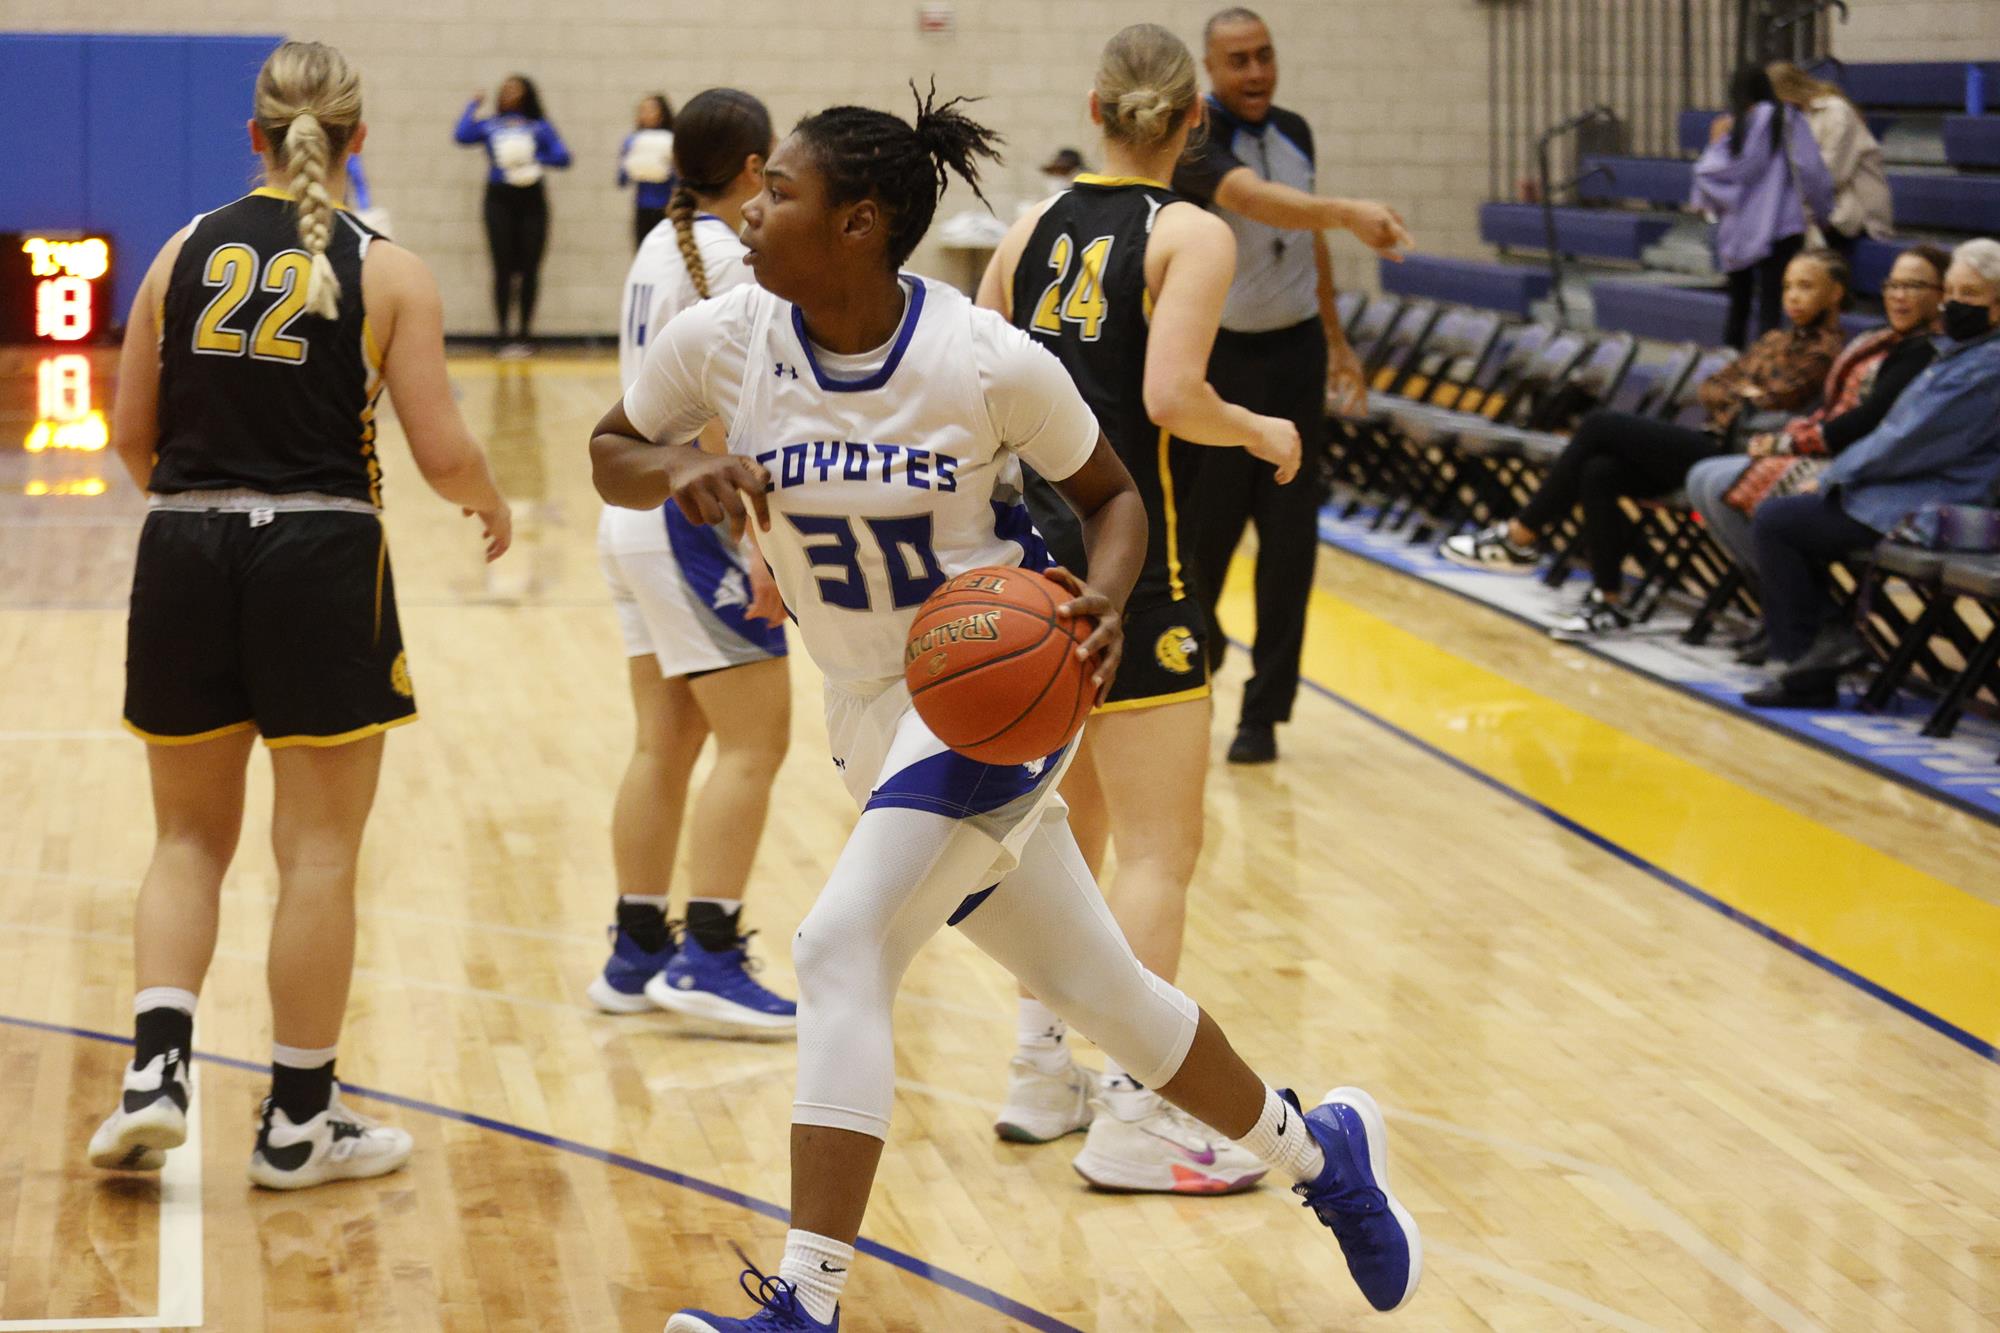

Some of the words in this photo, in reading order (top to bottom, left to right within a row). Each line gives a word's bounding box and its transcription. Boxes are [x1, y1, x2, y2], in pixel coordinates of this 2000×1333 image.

[36, 276, 92, 341] 18
[191, 242, 310, 366] 22
[1029, 232, 1115, 342] 24
[780, 510, 950, 613] 30
